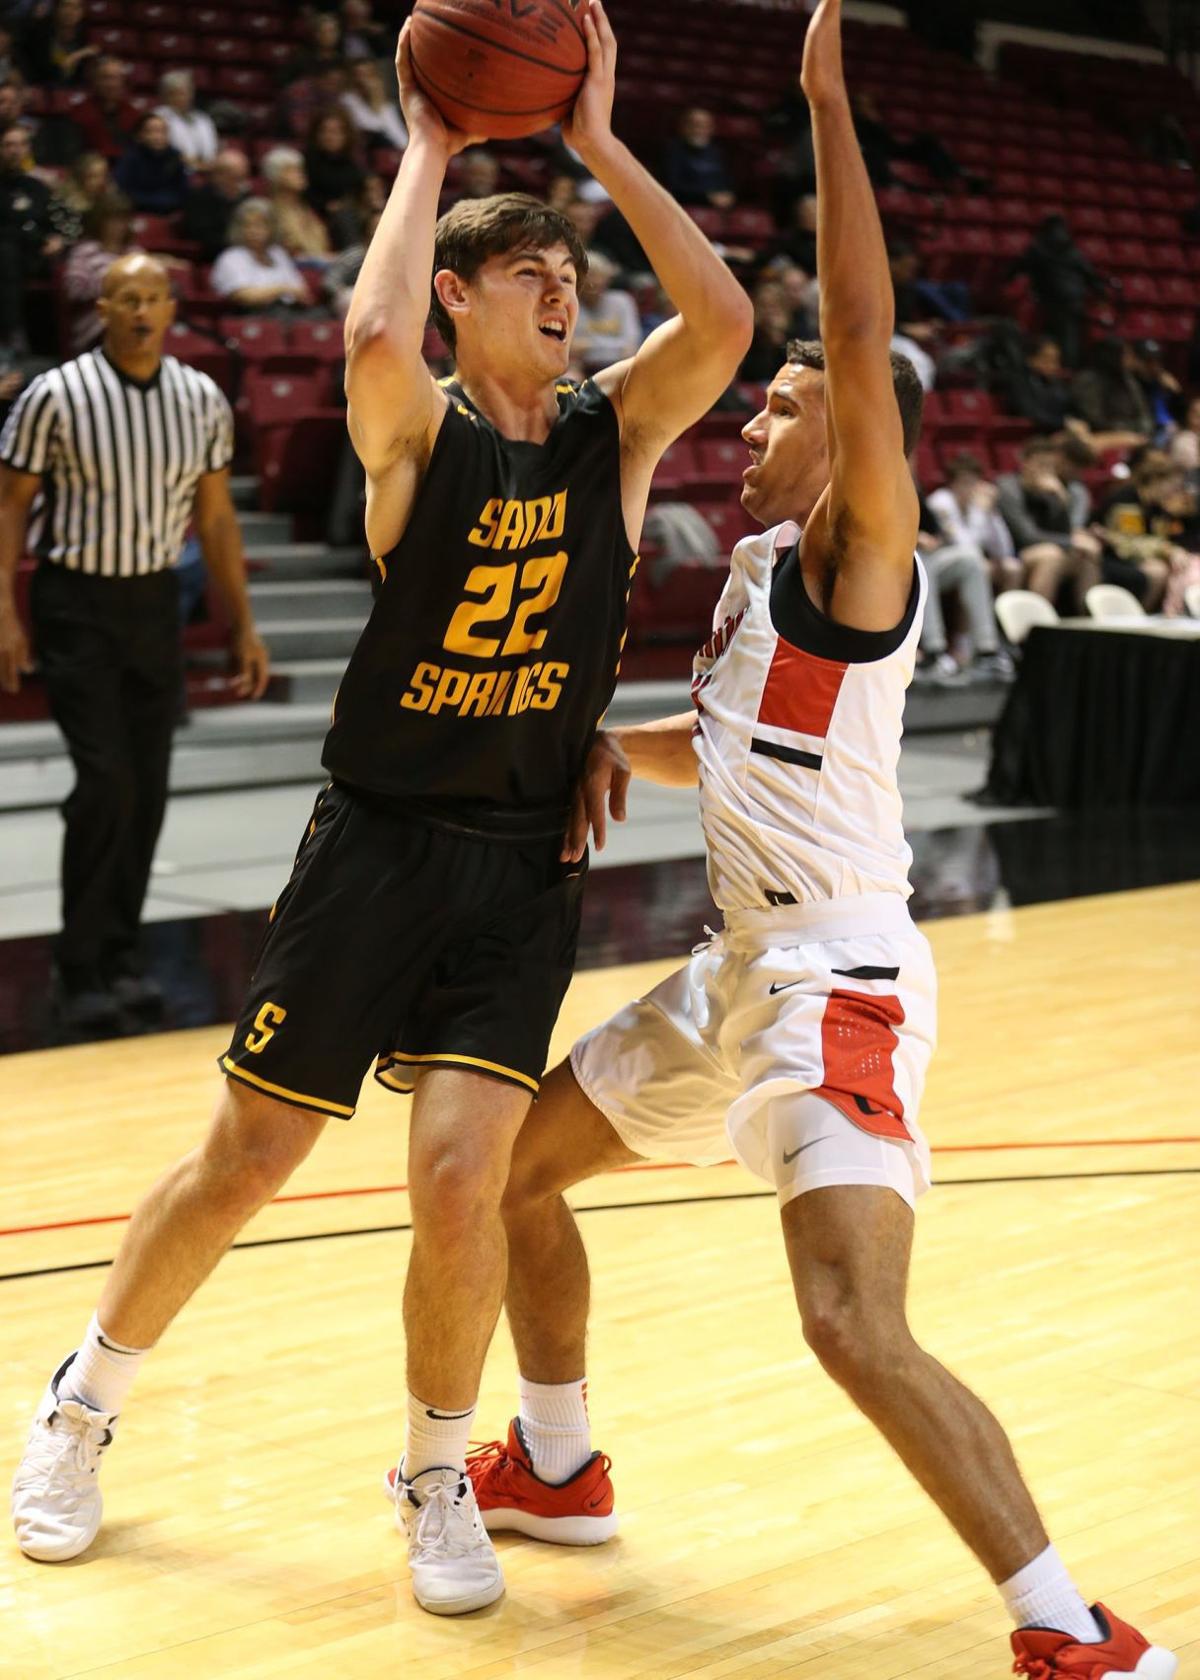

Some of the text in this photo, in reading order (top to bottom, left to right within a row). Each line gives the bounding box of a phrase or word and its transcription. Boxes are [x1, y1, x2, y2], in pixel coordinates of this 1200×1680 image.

[467, 488, 568, 550] SAND
[442, 550, 569, 658] 22
[399, 661, 570, 717] SPRINGS
[244, 1001, 287, 1054] S
